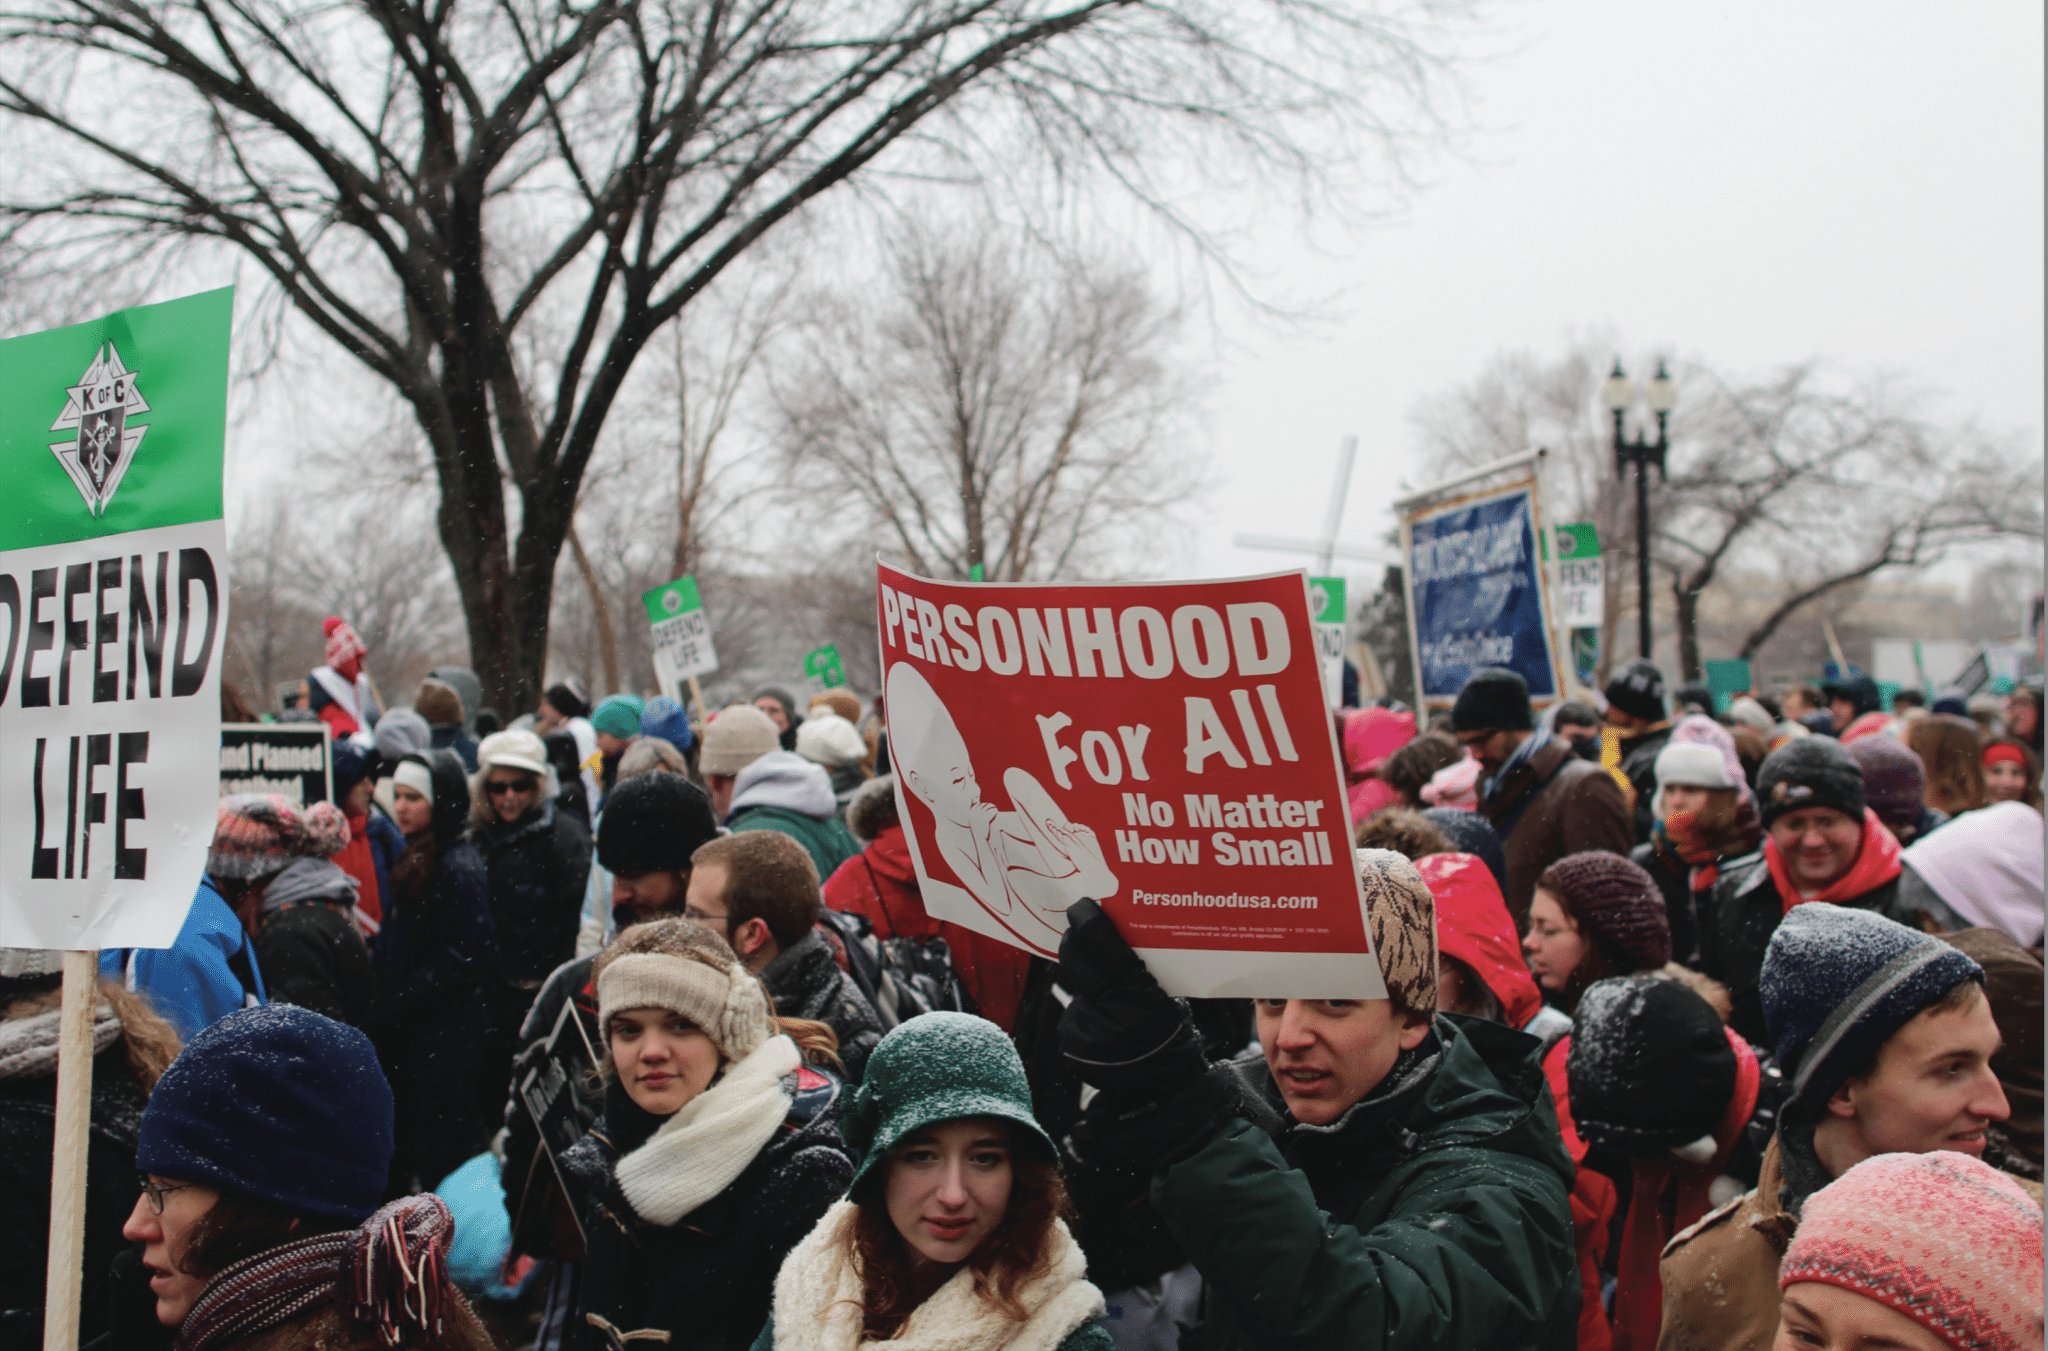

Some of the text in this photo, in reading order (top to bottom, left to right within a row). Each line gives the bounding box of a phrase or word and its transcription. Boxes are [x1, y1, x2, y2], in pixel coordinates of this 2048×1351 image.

[82, 387, 96, 412] K
[114, 379, 125, 404] C
[653, 614, 704, 648] DEFEND
[881, 583, 1292, 680] PERSONHOOD
[1035, 684, 1300, 791] For All
[251, 742, 323, 771] Planned
[31, 731, 150, 880] LIFE
[1121, 792, 1325, 829] No Matter
[1114, 829, 1334, 867] How Small
[1132, 889, 1319, 909] Personhoodusa.com
